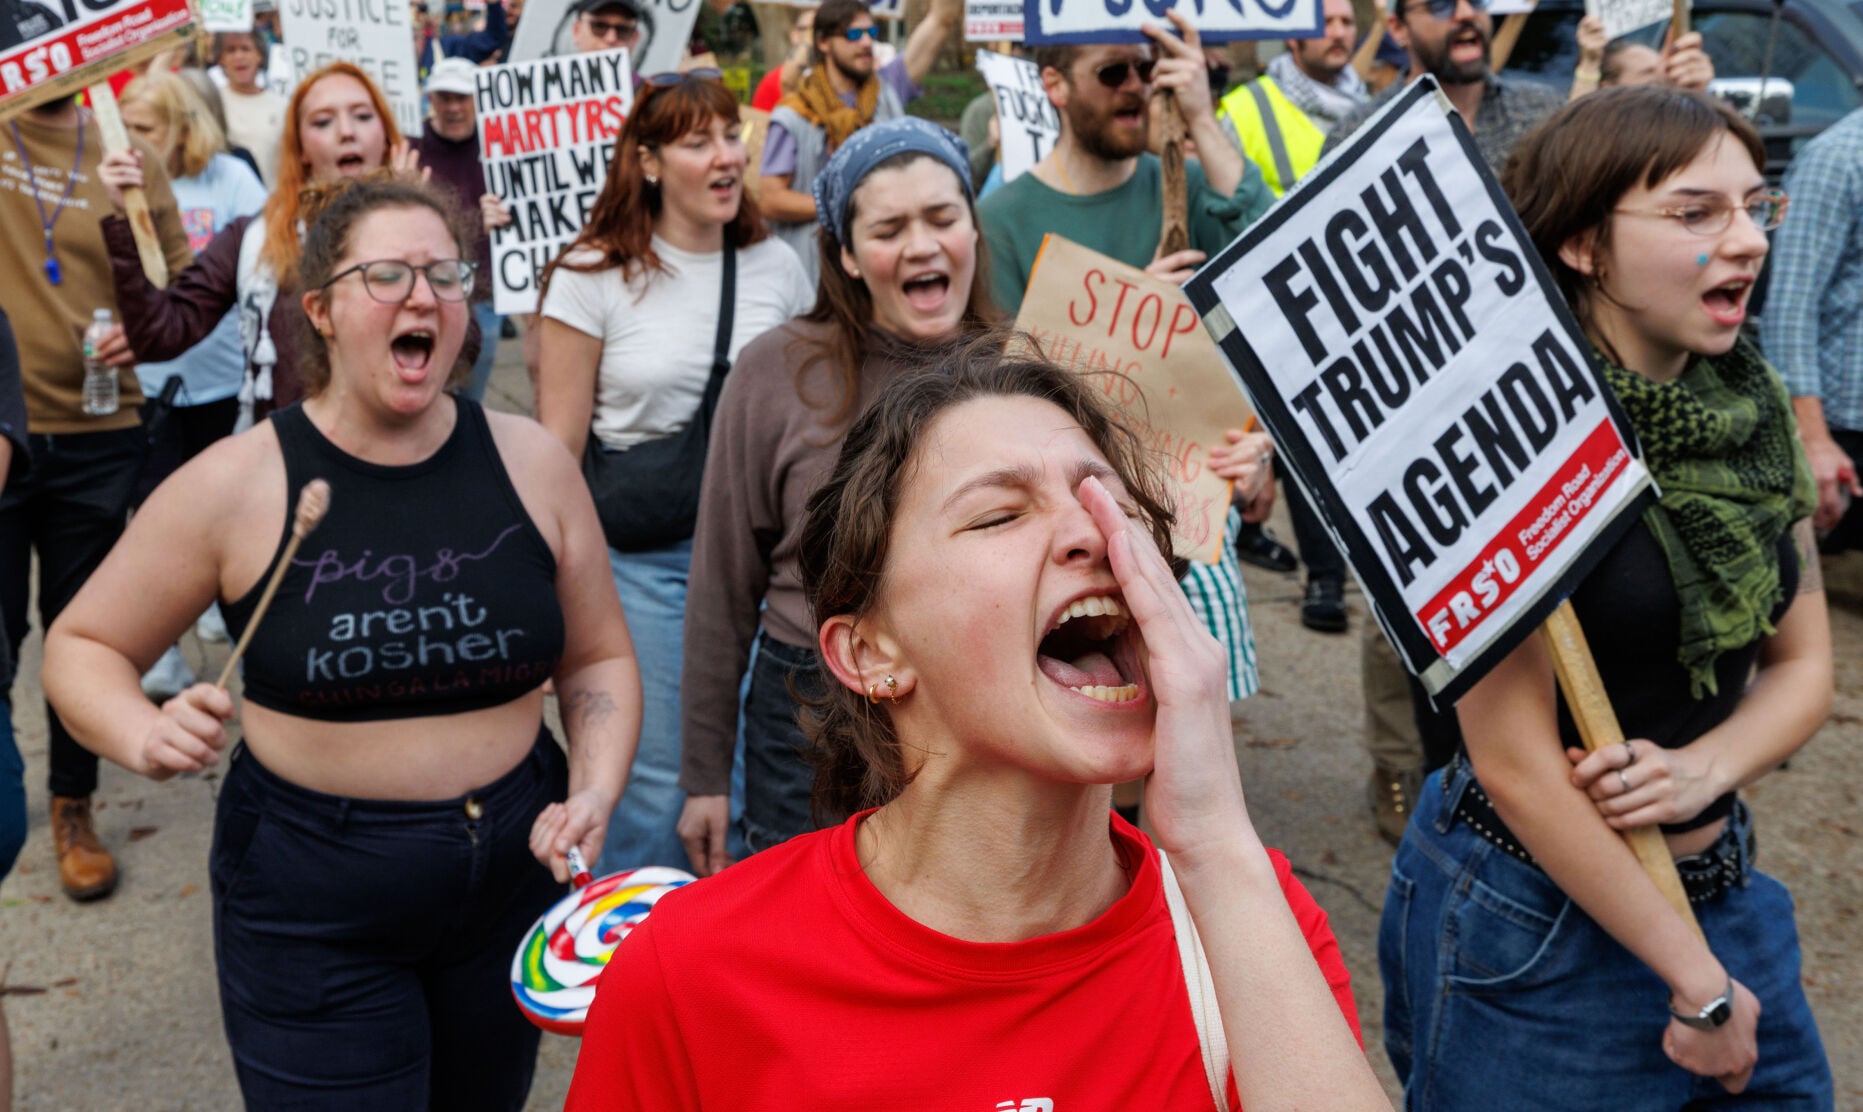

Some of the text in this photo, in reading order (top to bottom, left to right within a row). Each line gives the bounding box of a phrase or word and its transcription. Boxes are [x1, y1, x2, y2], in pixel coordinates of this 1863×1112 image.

[288, 0, 404, 26] JUSTICE
[326, 27, 363, 50] FOR
[475, 53, 623, 113] HOW MANY
[483, 96, 626, 158] MARTYRS
[487, 153, 571, 200] UNTIL
[494, 190, 597, 246] MAKE
[1262, 136, 1463, 367] FIGHT
[1068, 268, 1198, 360] STOP
[1290, 218, 1527, 464] TRUMP'S
[1365, 327, 1596, 588] AGENDA
[1517, 462, 1592, 547] Freedom Road
[292, 523, 523, 605] pigs
[1525, 512, 1572, 561] Socialist
[328, 592, 488, 641] aren't
[306, 629, 525, 683] kosher
